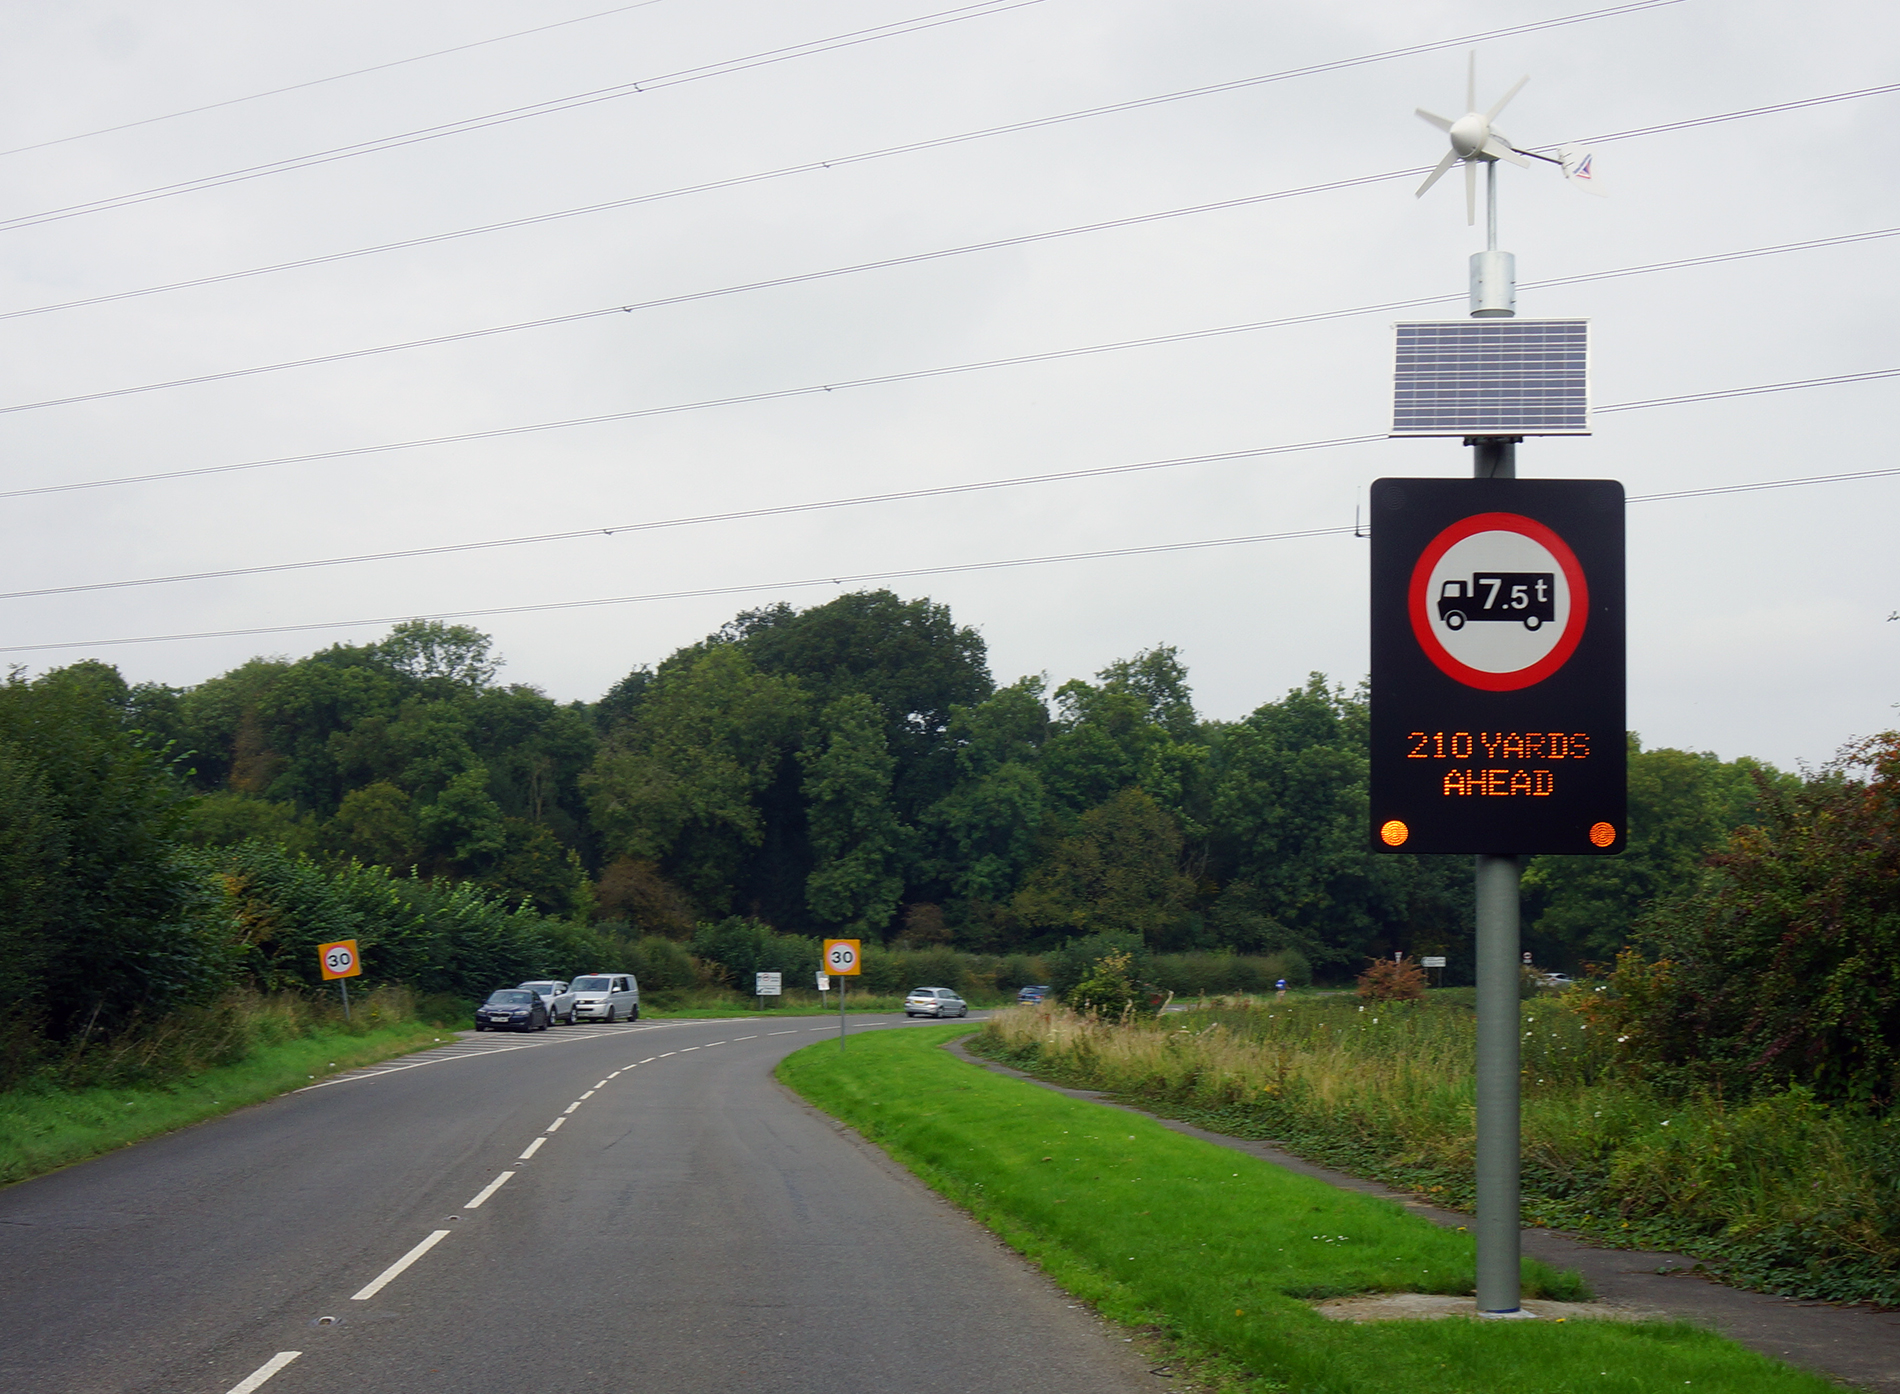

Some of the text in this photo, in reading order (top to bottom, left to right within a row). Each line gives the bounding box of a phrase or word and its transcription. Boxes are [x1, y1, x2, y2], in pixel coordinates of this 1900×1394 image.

[1407, 732, 1590, 759] 210 YARDS
[1443, 769, 1553, 796] AHEAD
[327, 953, 351, 967] 30
[831, 951, 853, 964] 30
